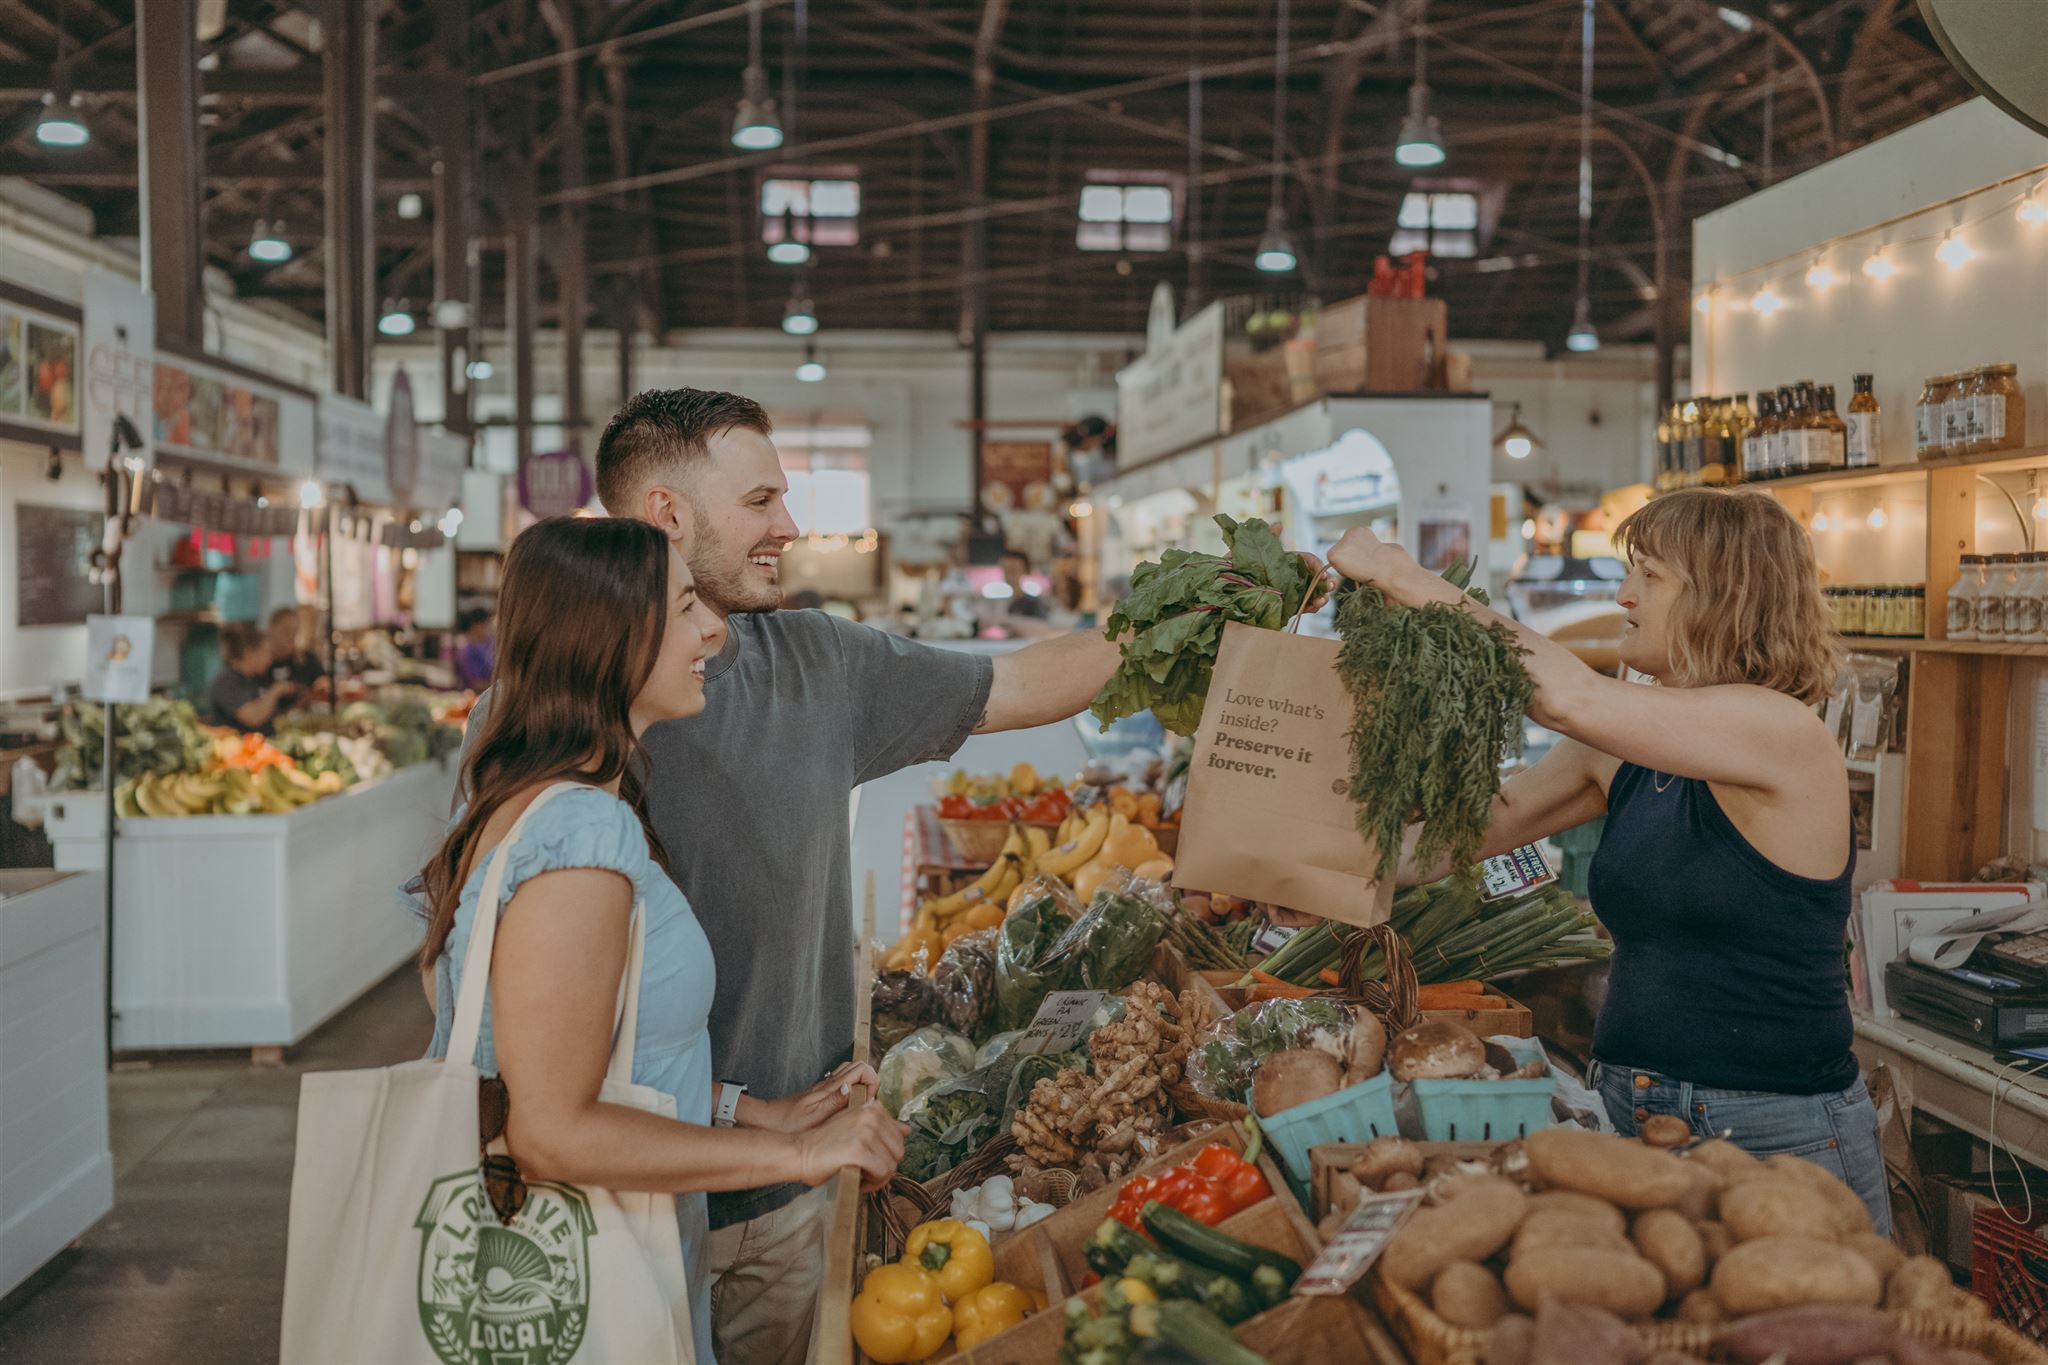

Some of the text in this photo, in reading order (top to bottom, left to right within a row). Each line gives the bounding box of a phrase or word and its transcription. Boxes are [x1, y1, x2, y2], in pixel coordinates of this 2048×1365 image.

[1224, 688, 1325, 720] Love what's
[1219, 710, 1279, 733] inside?
[1213, 731, 1312, 763] Preserve it
[1207, 753, 1277, 779] forever.
[1032, 1016, 1062, 1028] GREEN
[469, 1319, 555, 1351] LOCAL
